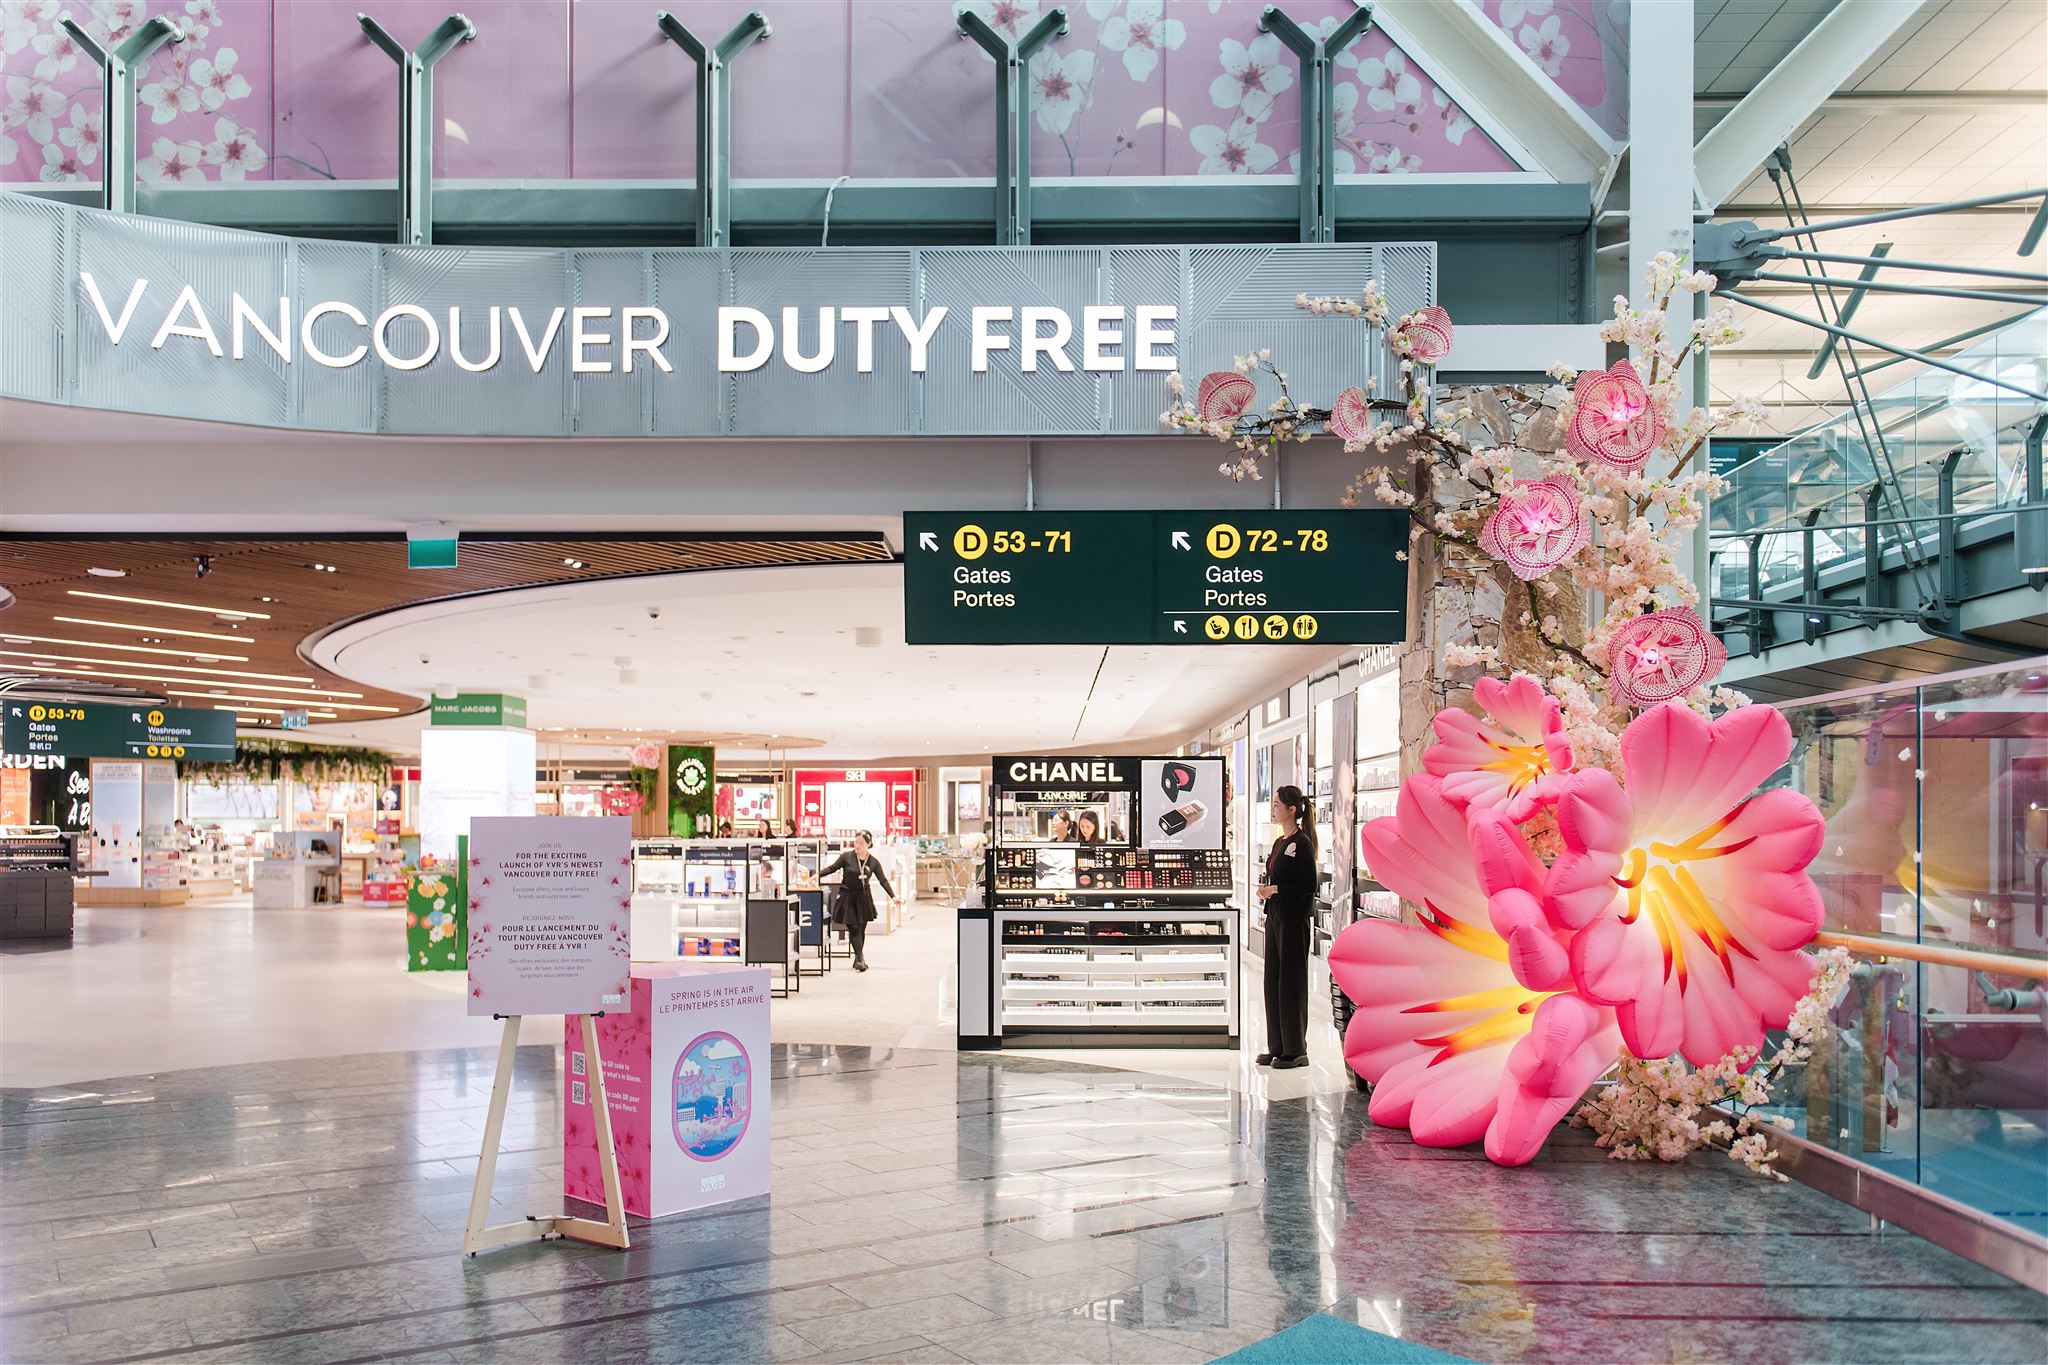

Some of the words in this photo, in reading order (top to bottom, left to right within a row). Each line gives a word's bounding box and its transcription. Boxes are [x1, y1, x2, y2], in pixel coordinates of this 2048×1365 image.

[79, 272, 674, 373] VANCOUVER
[717, 306, 950, 374] DUTY
[971, 306, 1178, 373] FREE
[963, 532, 981, 552] D
[1215, 531, 1234, 551] D
[953, 566, 1012, 584] Gates
[1205, 565, 1264, 583] Gates
[953, 590, 1016, 607] Portes
[1205, 589, 1267, 606] Portes
[1359, 645, 1396, 677] CHANEL
[29, 723, 56, 732] Gates
[148, 727, 191, 735] Washrooms
[29, 733, 59, 741] Portes
[1009, 762, 1124, 782] CHANEL
[559, 942, 565, 950] À
[671, 990, 701, 1001] SPRING
[703, 989, 711, 998] IS
[724, 987, 739, 995] THE
[741, 985, 754, 994] AIR
[659, 1005, 670, 1014] LE
[672, 1000, 719, 1012] PRINTEMPS
[720, 998, 735, 1007] EST
[737, 994, 764, 1006] ARRIVÉ
